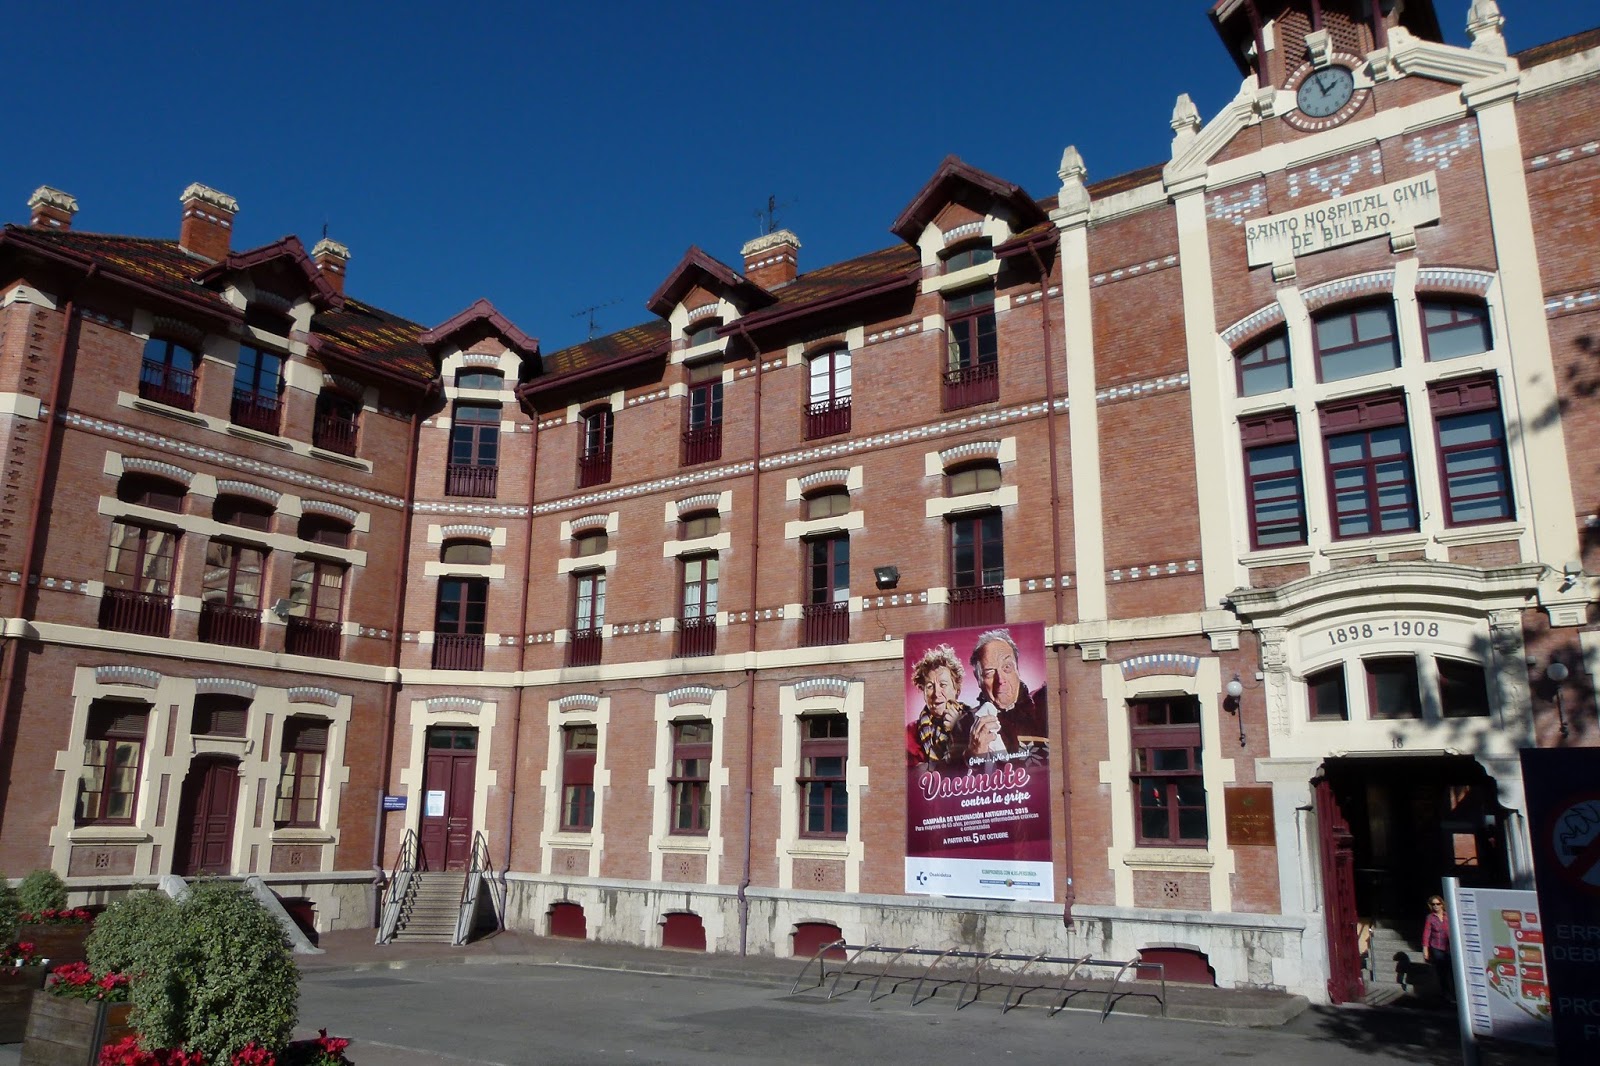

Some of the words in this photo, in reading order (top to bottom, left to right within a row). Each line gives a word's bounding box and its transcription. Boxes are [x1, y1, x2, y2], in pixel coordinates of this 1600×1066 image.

[1247, 217, 1299, 241] SANTO
[1304, 193, 1388, 228] HOSPITAL
[1393, 179, 1437, 204] CIVIL
[1291, 232, 1314, 250] DE
[1391, 737, 1404, 749] 18
[918, 762, 1031, 801] Vacúnate
[961, 794, 991, 808] contra
[993, 791, 1003, 804] la
[1004, 789, 1031, 808] gripe
[922, 816, 946, 826] CAMPAÑA
[947, 815, 953, 823] DE
[953, 811, 984, 821] VACUNACIÓN
[985, 808, 1014, 818] ANTIGRIPAL
[948, 836, 963, 844] PARTIR
[963, 835, 972, 843] DEL
[972, 832, 979, 844] 5
[986, 831, 1009, 840] OCTUBRE
[1553, 945, 1600, 962] DEB
